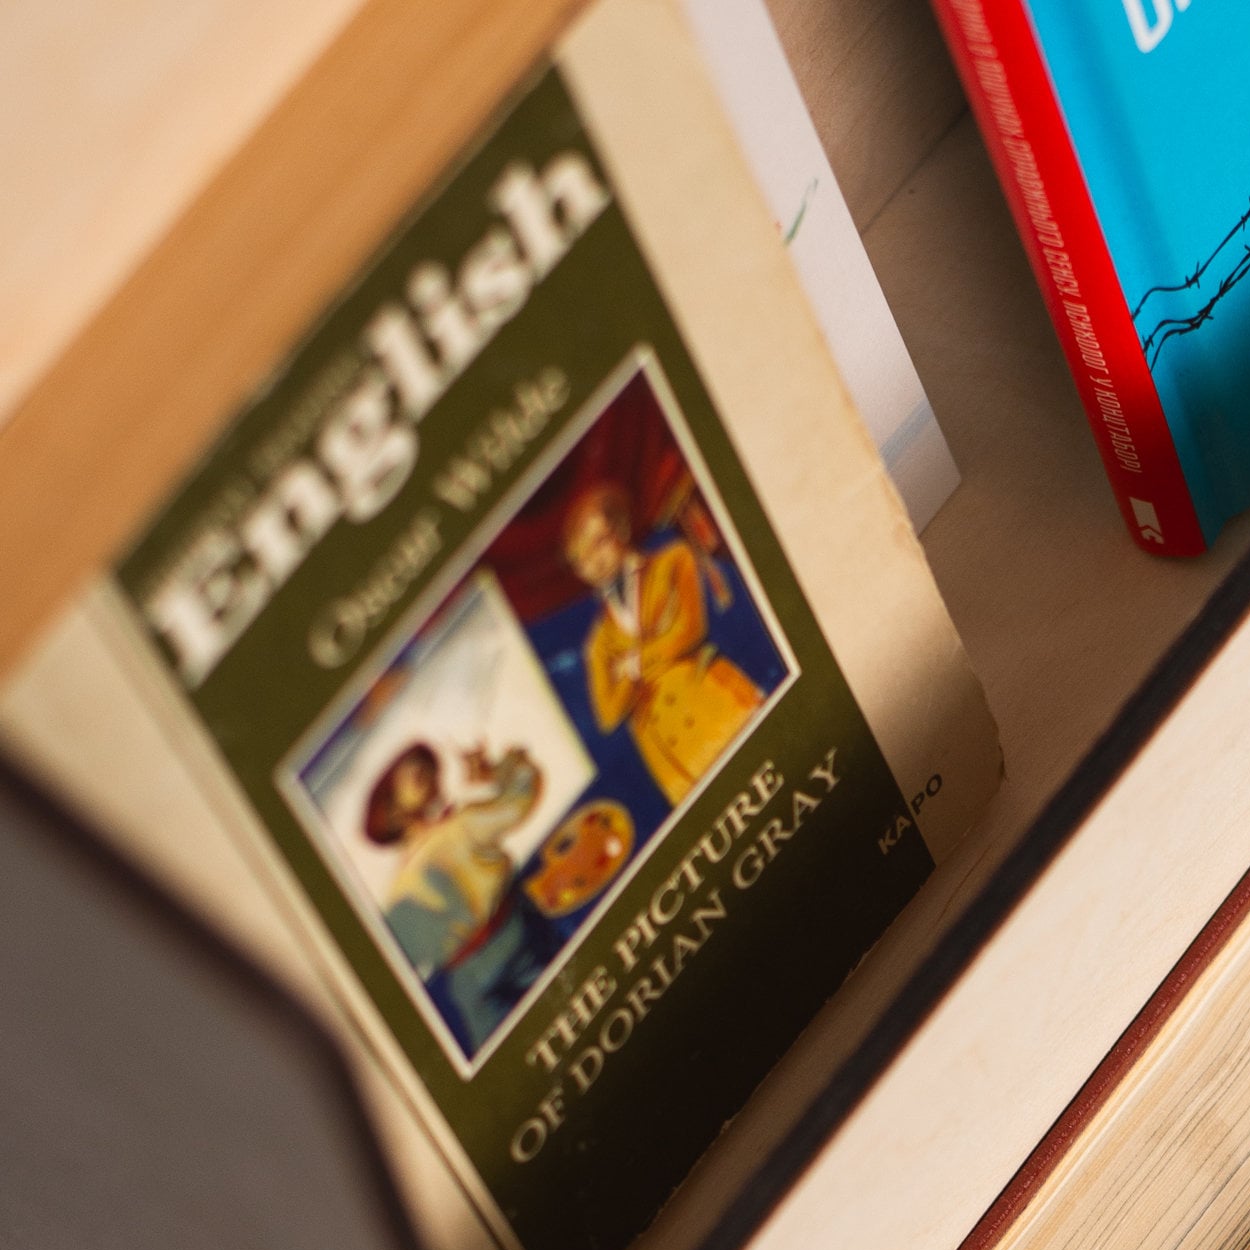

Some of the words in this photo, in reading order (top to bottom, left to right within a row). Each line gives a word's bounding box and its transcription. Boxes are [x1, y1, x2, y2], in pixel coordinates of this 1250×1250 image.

[139, 150, 613, 689] English
[1063, 299, 1110, 374] ПСИХОЛОГ
[1089, 374, 1114, 391] У
[1096, 386, 1143, 474] КОНЦТАБОРІ
[509, 1085, 566, 1164] OF
[571, 892, 730, 1097] DORIAN
[731, 747, 842, 891] GRAY
[526, 960, 618, 1076] THE
[612, 759, 786, 973] PICTURE
